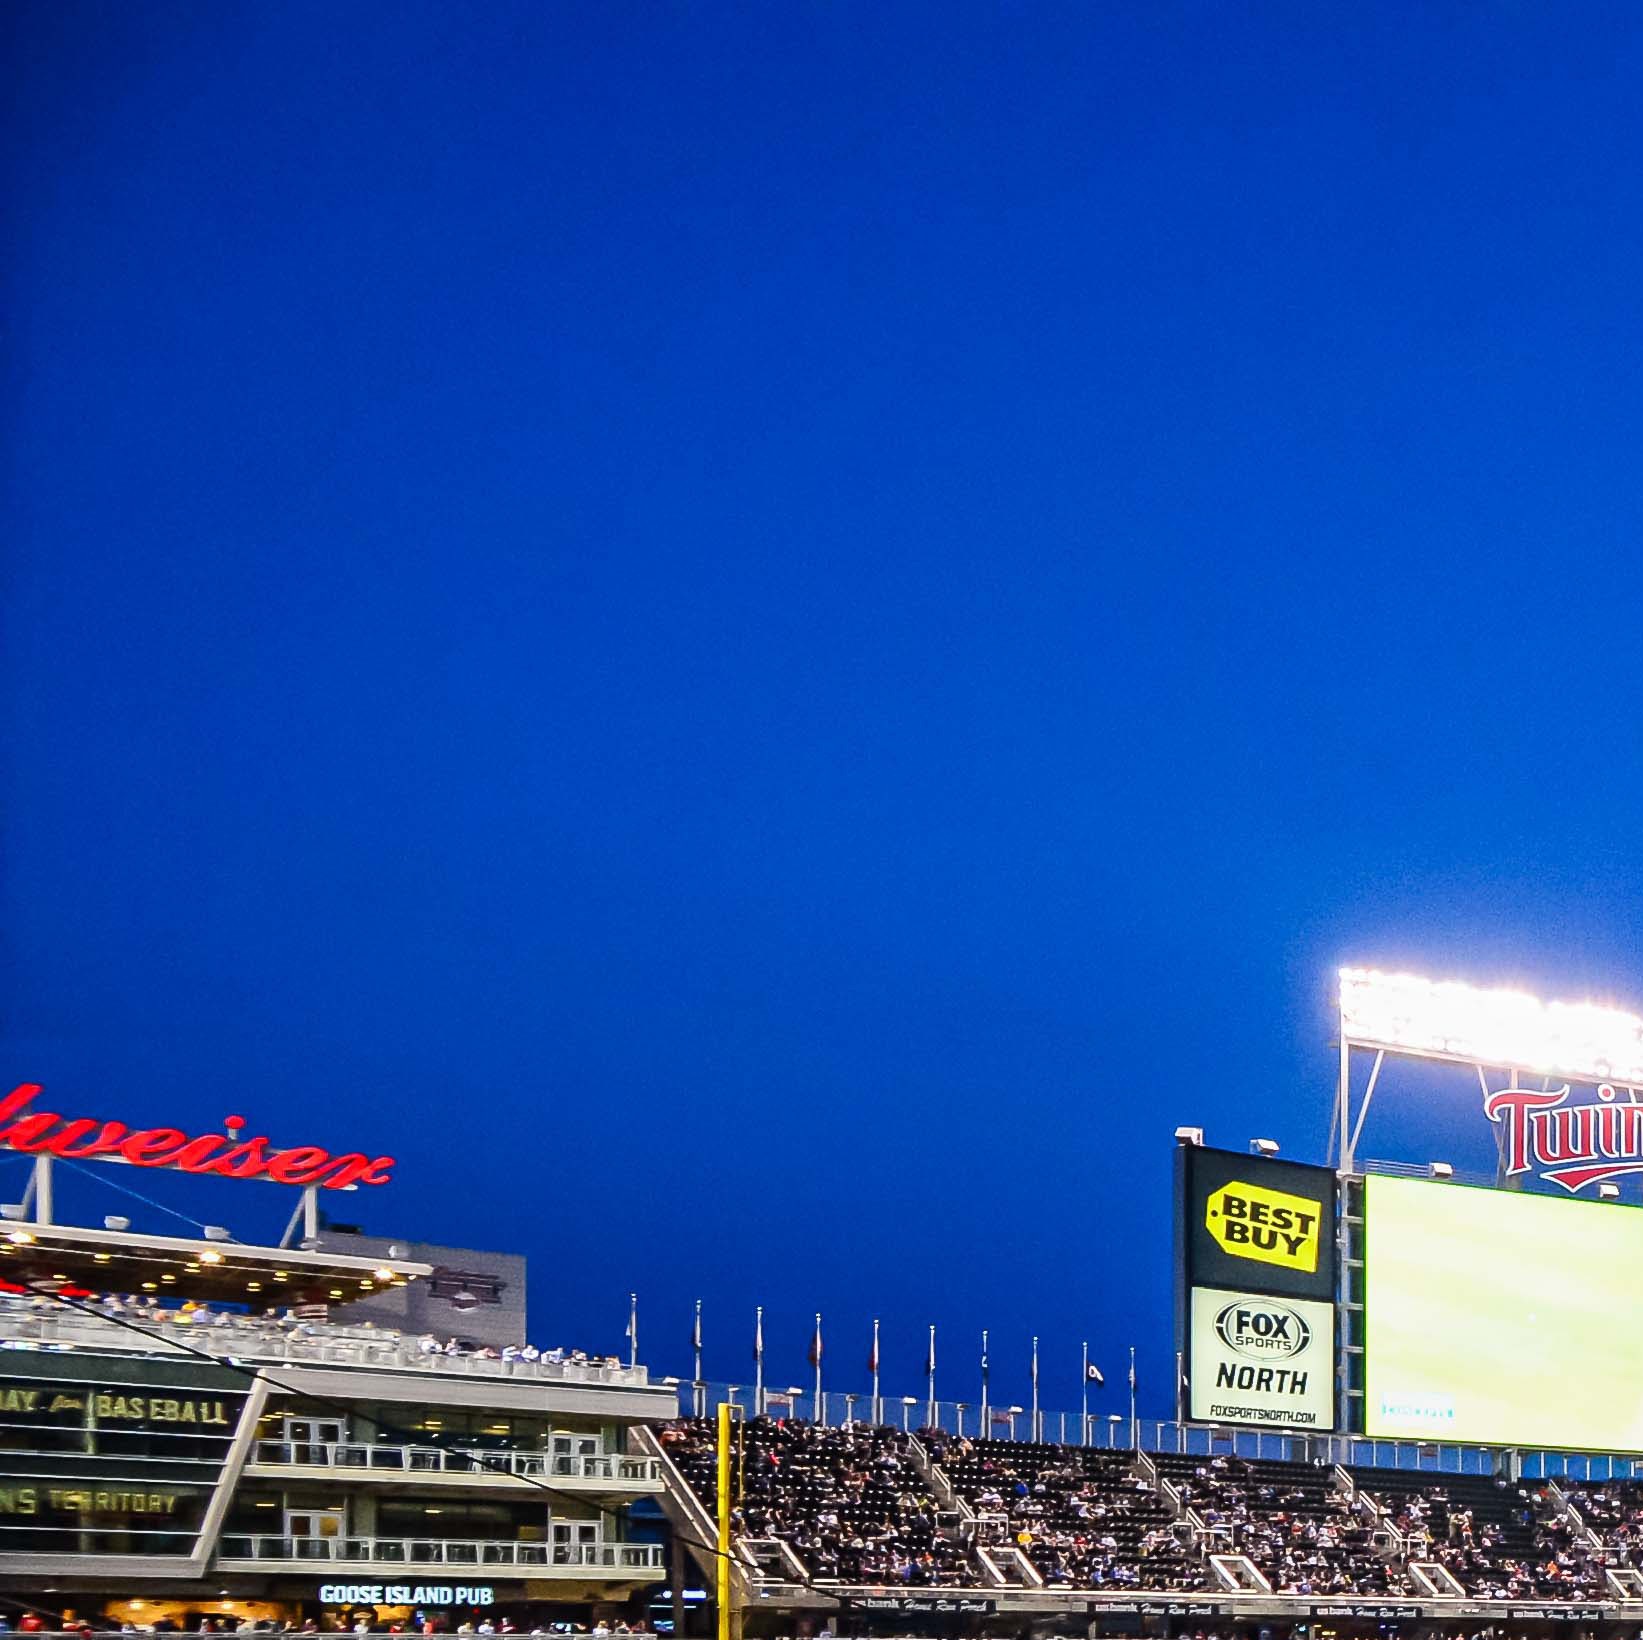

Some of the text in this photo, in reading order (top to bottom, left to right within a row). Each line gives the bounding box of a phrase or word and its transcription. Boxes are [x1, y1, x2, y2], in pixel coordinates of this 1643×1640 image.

[1222, 1194, 1316, 1235] BEST
[1224, 1219, 1307, 1256] BUY
[1236, 1310, 1291, 1340] FOX
[1235, 1336, 1292, 1351] SPORTS
[1216, 1362, 1308, 1395] NORTH
[95, 1395, 228, 1425] BASEBALL
[1210, 1404, 1316, 1424] FOXSPORTSNORTH.COM
[320, 1585, 494, 1606] GOOSE ISLAND PUB
